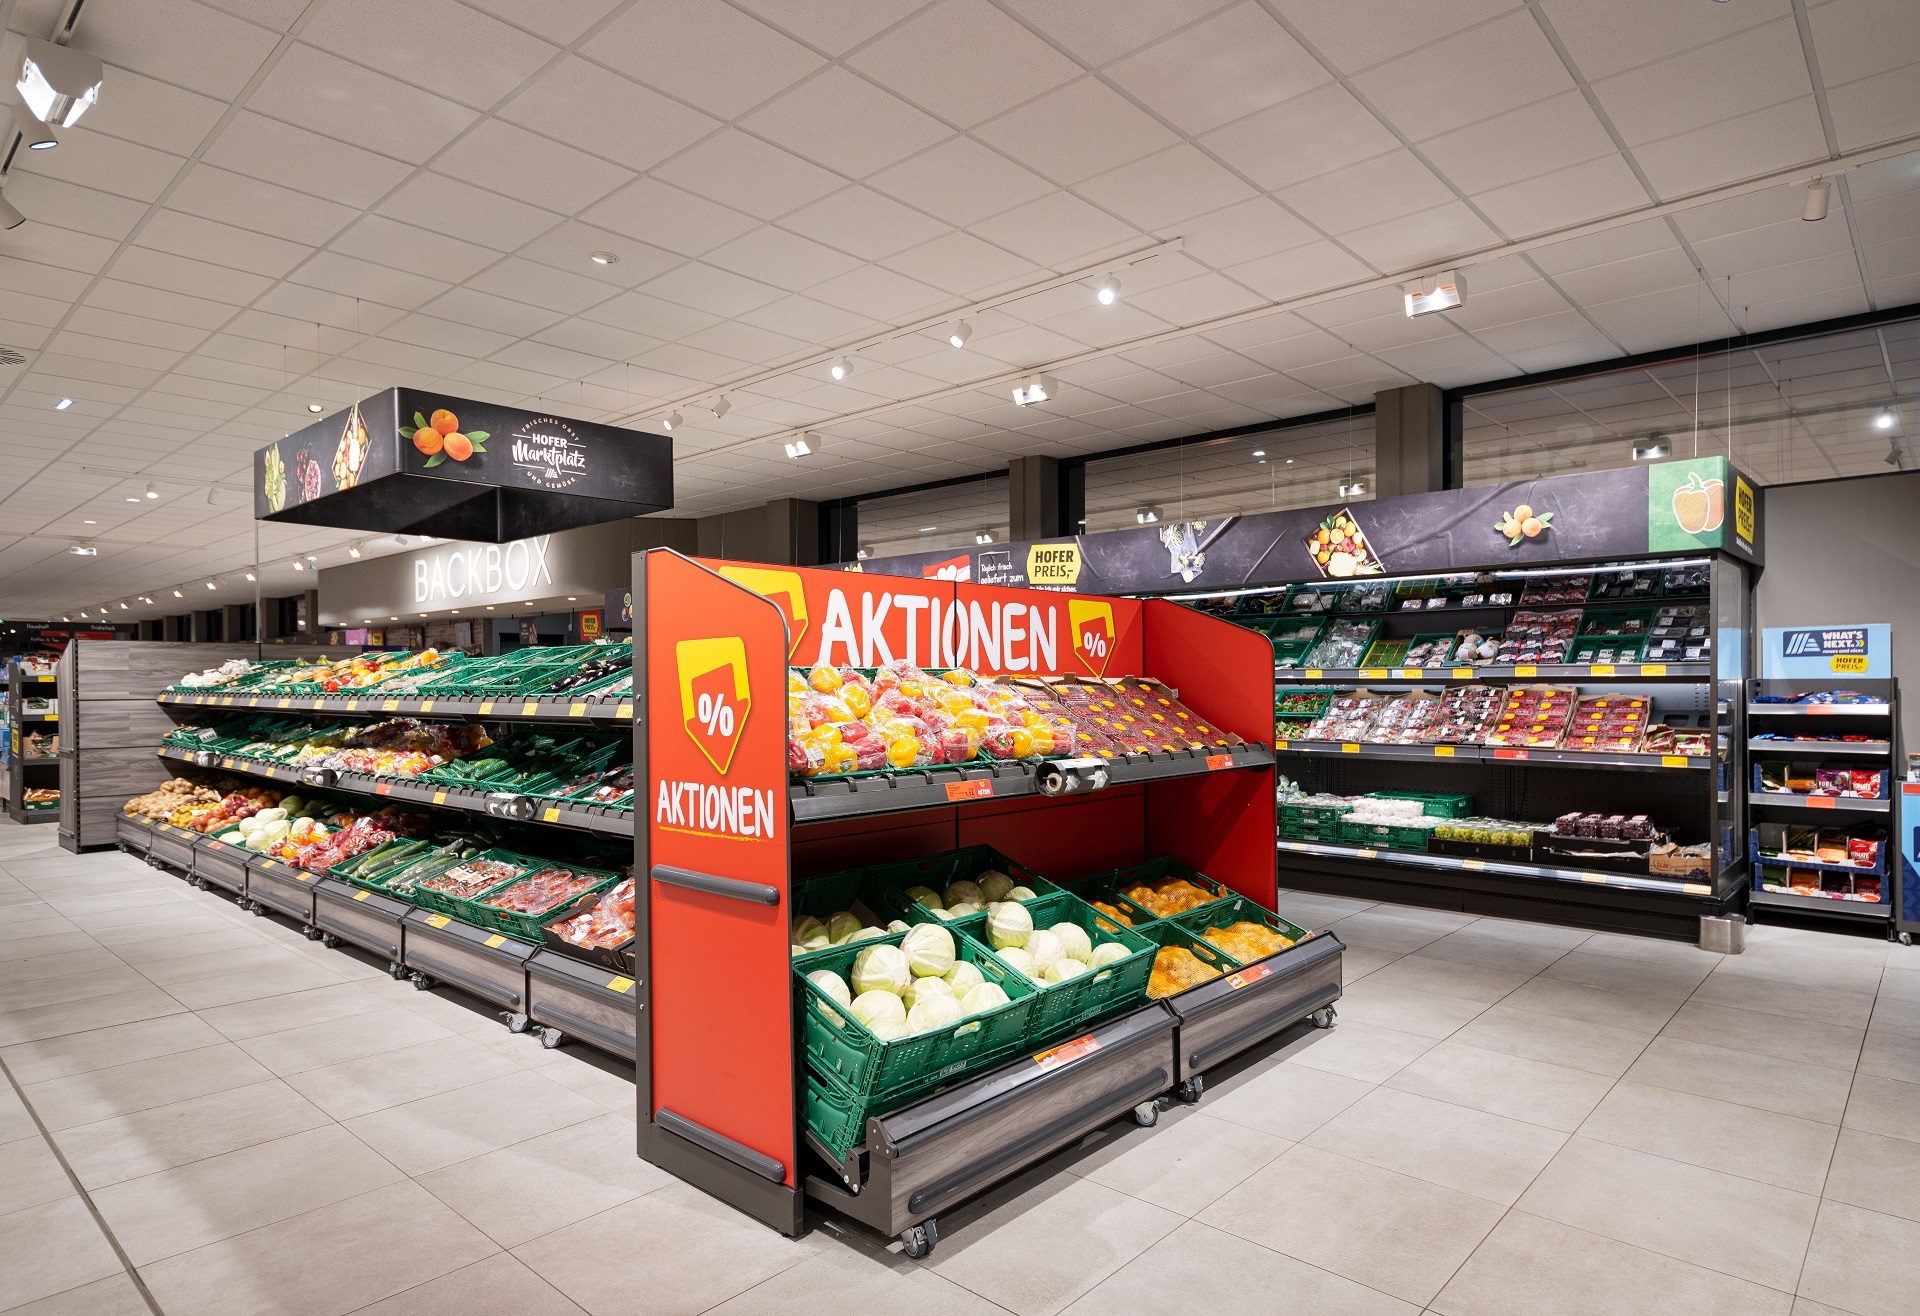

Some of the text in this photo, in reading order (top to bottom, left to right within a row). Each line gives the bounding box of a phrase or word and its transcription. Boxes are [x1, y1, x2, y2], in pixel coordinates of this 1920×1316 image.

[522, 418, 579, 441] FRISCHES OBST
[532, 432, 567, 448] HOFER
[512, 439, 586, 475] Marktplatz
[527, 471, 576, 488] UND GEMÜSE
[1035, 550, 1074, 563] HOFER
[415, 535, 552, 603] BACKBOX
[997, 562, 1012, 571] frisch
[1034, 565, 1074, 579] PREIS,-
[1009, 574, 1024, 583] zum
[818, 588, 1057, 671] AKTIONEN
[1822, 630, 1863, 640] WHAT'S
[1823, 640, 1854, 648] NEXT.
[1853, 782, 1871, 791] TOMATE
[657, 780, 774, 839] AKTIONEN
[1851, 851, 1869, 859] TOMATE
